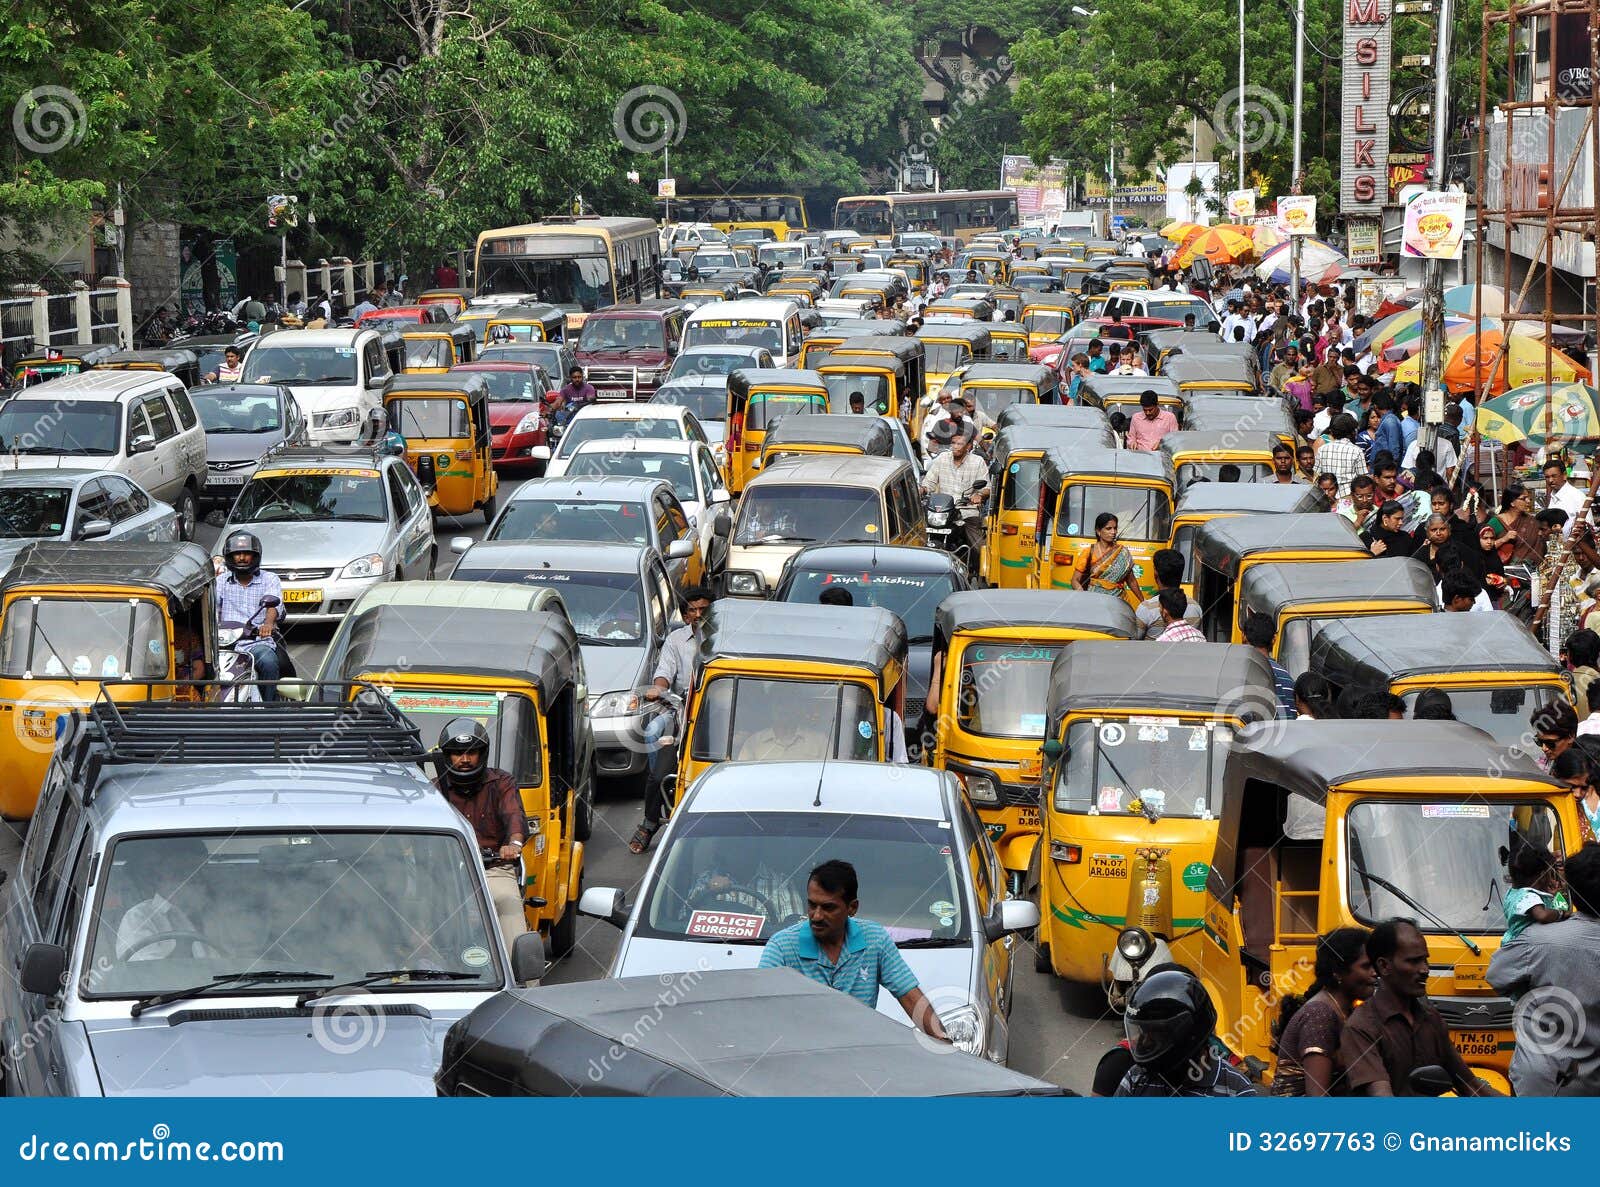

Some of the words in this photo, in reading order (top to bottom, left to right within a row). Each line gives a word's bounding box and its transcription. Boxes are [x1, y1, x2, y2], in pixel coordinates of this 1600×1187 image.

[1569, 67, 1589, 79] VBC
[1354, 38, 1377, 202] SILKS
[1115, 186, 1157, 194] anasonic
[738, 320, 768, 328] Travels
[623, 503, 637, 518] L
[821, 573, 858, 585] Jaya
[862, 572, 925, 588] Lakshmi
[1022, 808, 1039, 817] TN.
[1018, 817, 1040, 825] D.86
[1094, 859, 1123, 867] TN.07
[1090, 867, 1126, 877] AR.0466
[696, 914, 757, 928] POLICE
[692, 924, 754, 937] SURGEON
[1460, 1033, 1494, 1042] TN.10
[1456, 1044, 1497, 1055] AF.0668
